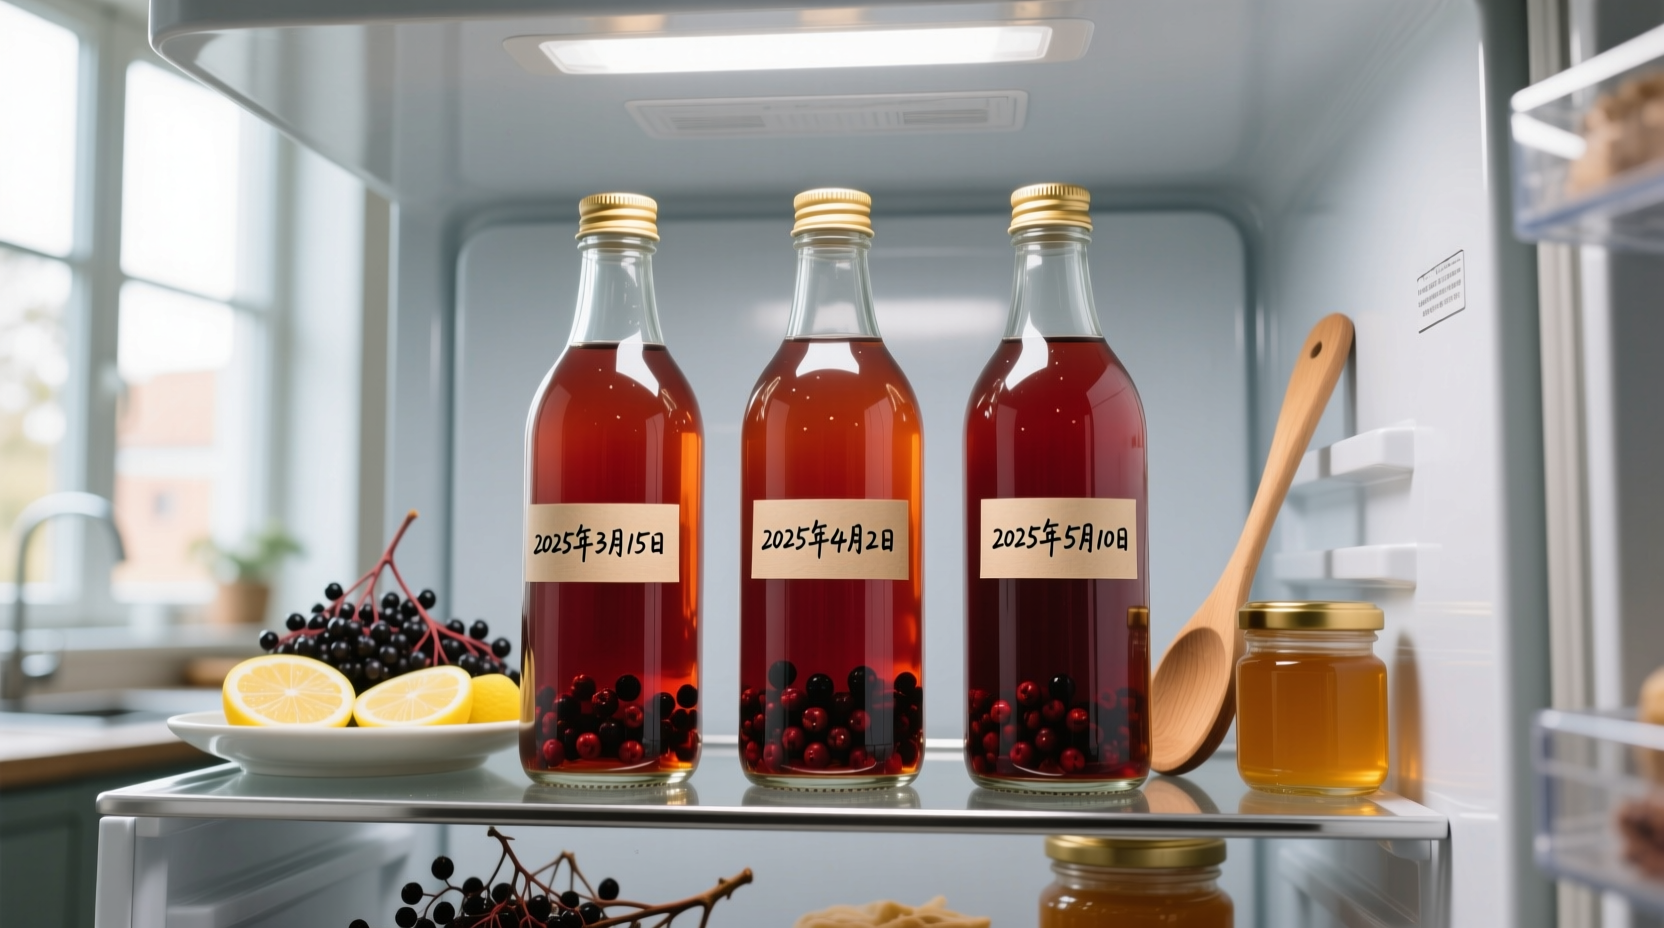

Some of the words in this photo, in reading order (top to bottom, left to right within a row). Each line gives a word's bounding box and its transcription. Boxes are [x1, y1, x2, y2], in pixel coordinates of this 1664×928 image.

[533, 523, 664, 563] 2025年3月15日
[761, 519, 894, 560] 2025年4月2日
[992, 517, 1128, 558] 2025年5月10日
